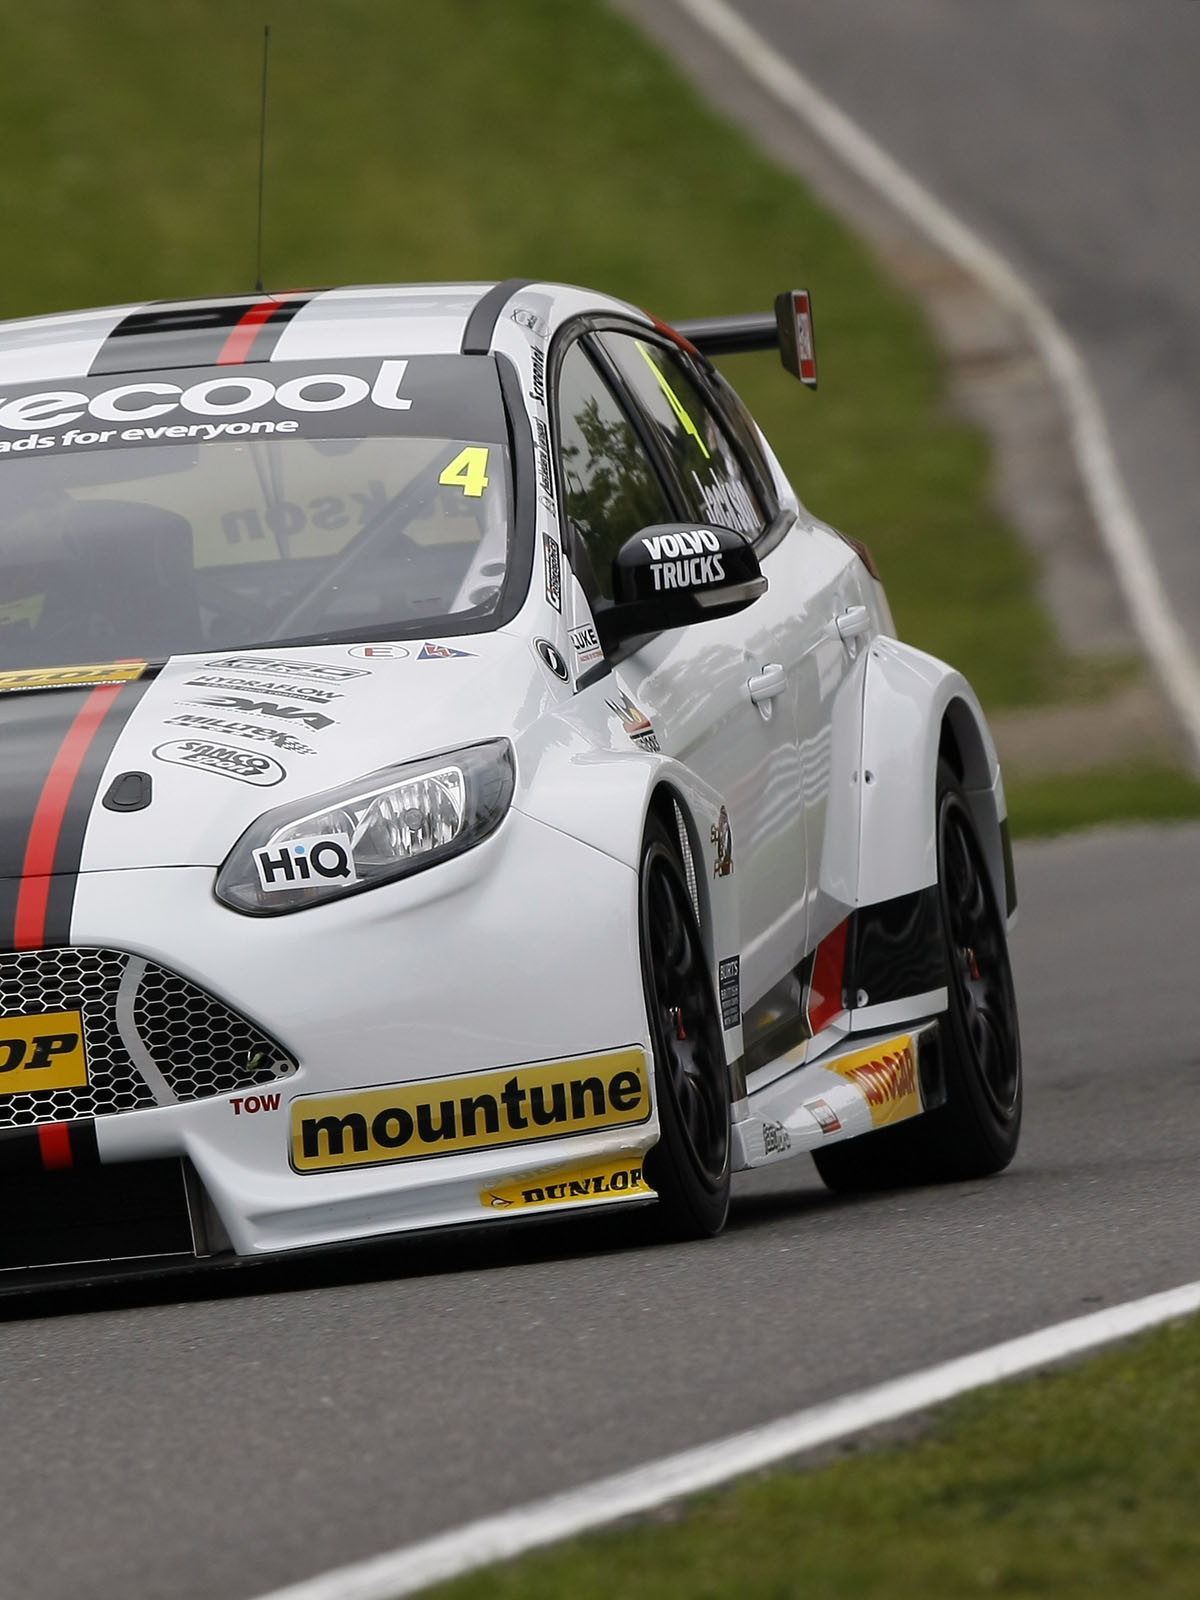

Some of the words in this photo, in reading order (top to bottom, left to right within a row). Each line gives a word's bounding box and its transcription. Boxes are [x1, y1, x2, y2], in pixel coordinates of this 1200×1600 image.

[61, 430, 117, 446] for
[121, 420, 299, 440] everyone
[438, 446, 489, 497] 4
[642, 530, 720, 560] VOLVO
[651, 553, 725, 590] TRUCKS
[194, 675, 345, 699] HYDRAFLOW
[260, 841, 351, 882] HiQ
[229, 1093, 281, 1115] TOW
[303, 1077, 641, 1158] mountune
[521, 1168, 641, 1203] DUNLOP
